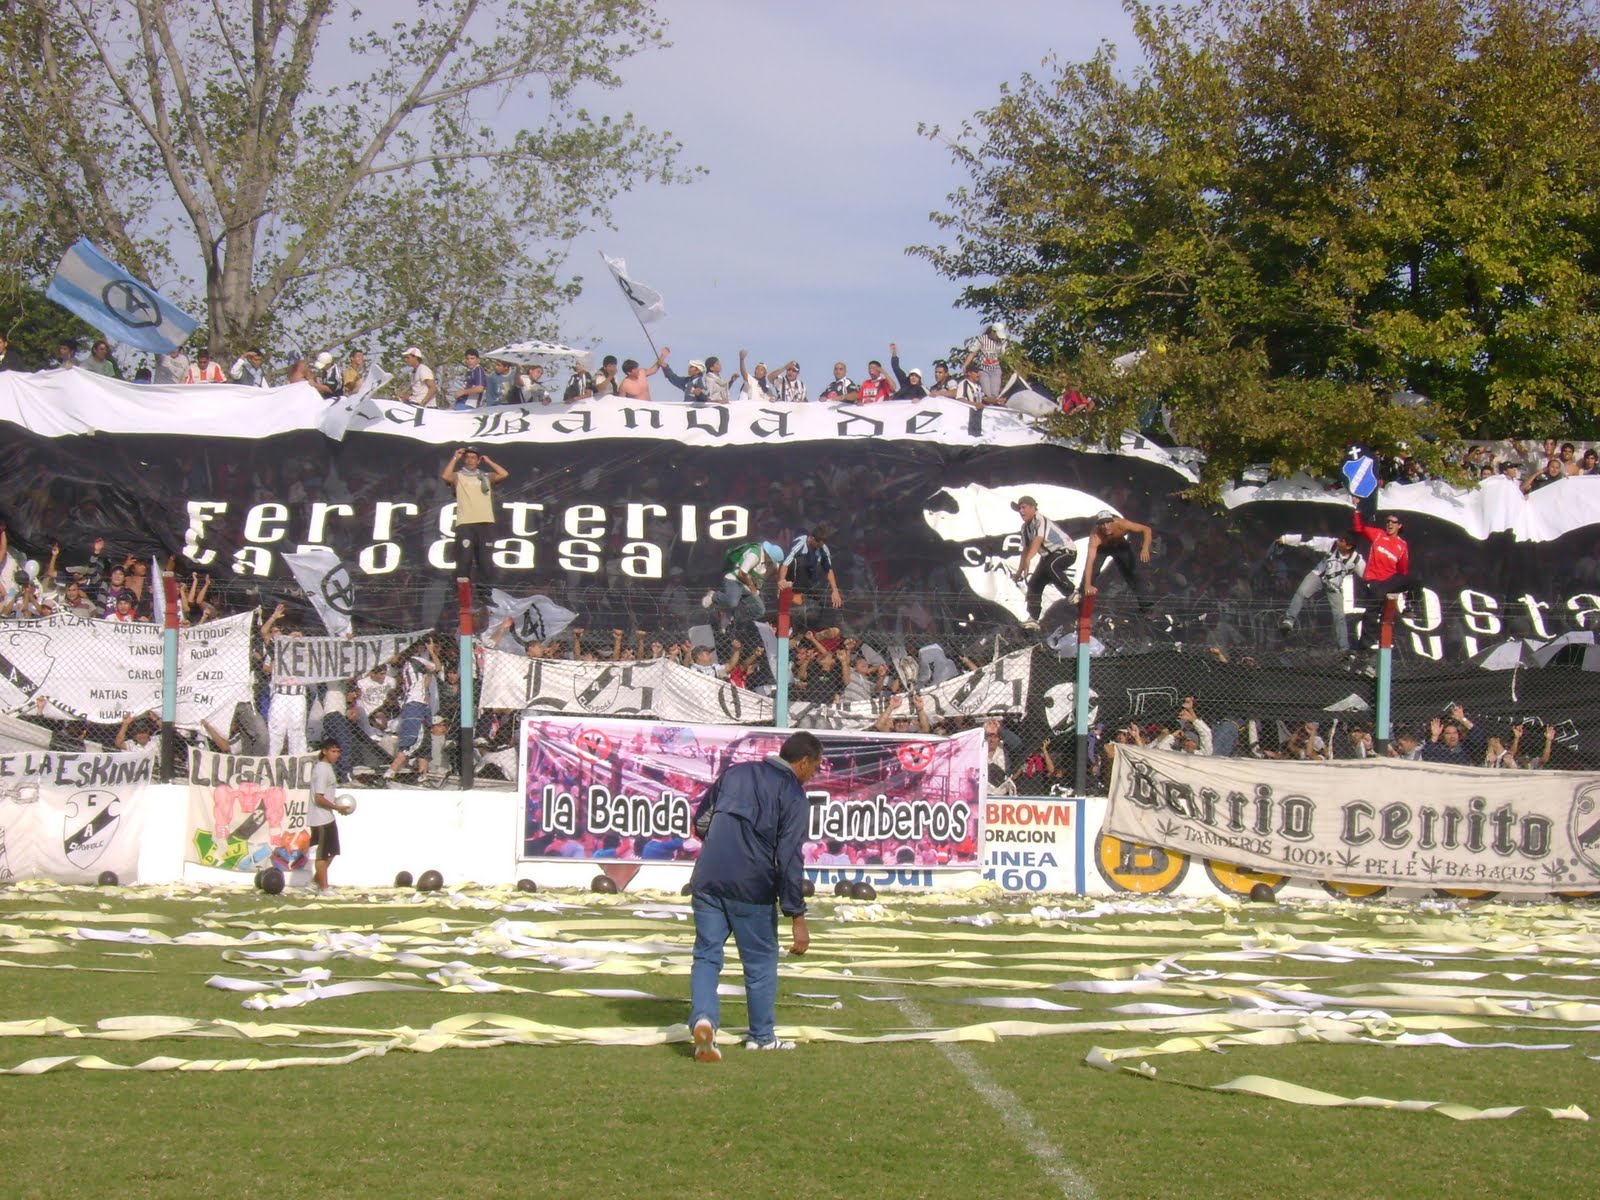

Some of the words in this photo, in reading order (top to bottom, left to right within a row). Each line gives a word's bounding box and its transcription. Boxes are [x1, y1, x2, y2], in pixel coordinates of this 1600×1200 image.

[113, 623, 160, 635] AGUSTIN
[276, 639, 383, 678] KENNEDY
[197, 670, 224, 681] ENZO
[90, 689, 128, 700] MATIAS
[194, 693, 214, 705] EMI
[24, 752, 53, 776] LA
[1125, 758, 1317, 843] Barrio
[288, 816, 305, 829] 20
[587, 785, 691, 837] Banda
[807, 792, 970, 842] Tamberos
[985, 803, 1071, 827] BROWN
[1184, 825, 1273, 855] TAMBEROS
